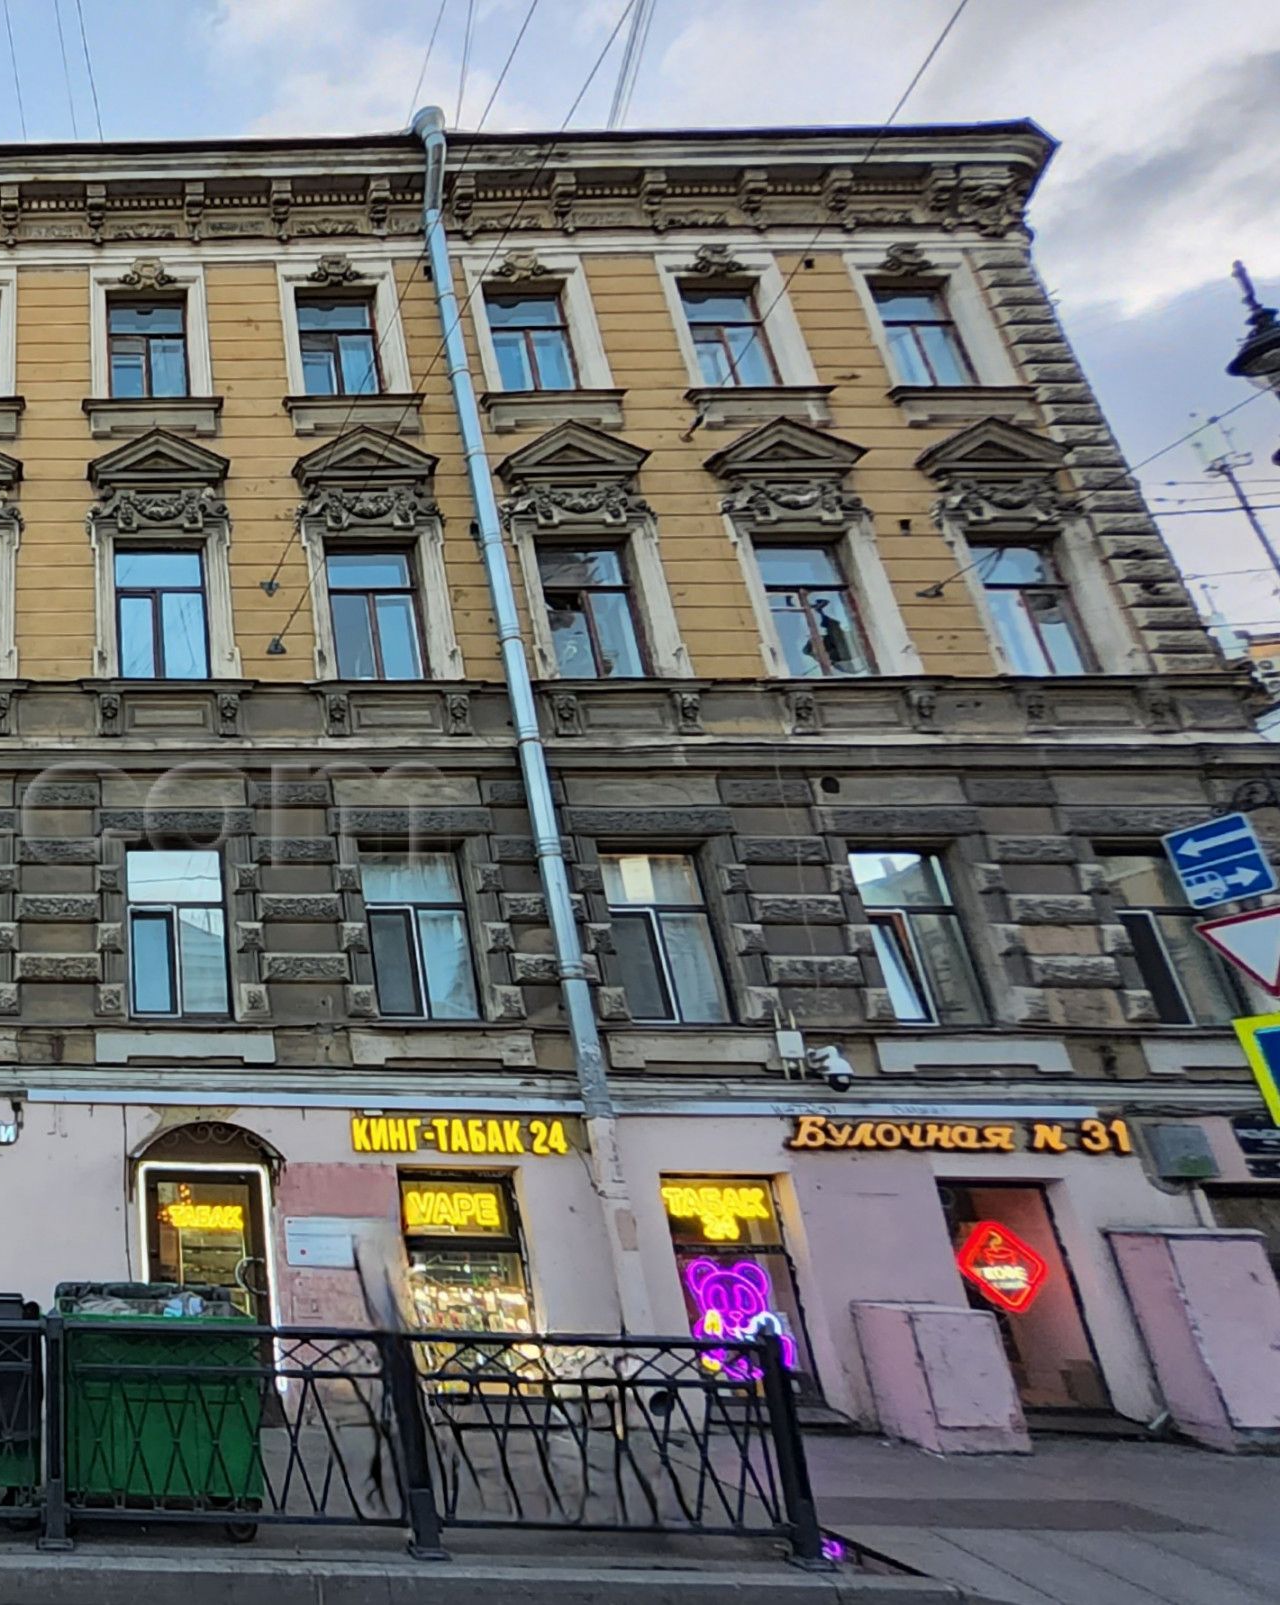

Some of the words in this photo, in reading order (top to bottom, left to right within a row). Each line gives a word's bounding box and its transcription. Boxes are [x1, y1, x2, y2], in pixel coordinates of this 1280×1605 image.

[352, 1117, 524, 1153] КИНГ-ТАБАК
[530, 1120, 569, 1155] 24
[790, 1116, 1015, 1150] Булочная
[1081, 1118, 1133, 1152] 31
[168, 1205, 244, 1229] ТАБАК
[405, 1191, 500, 1226] VAPE
[661, 1187, 770, 1218] ТАБАК
[701, 1213, 740, 1240] 24
